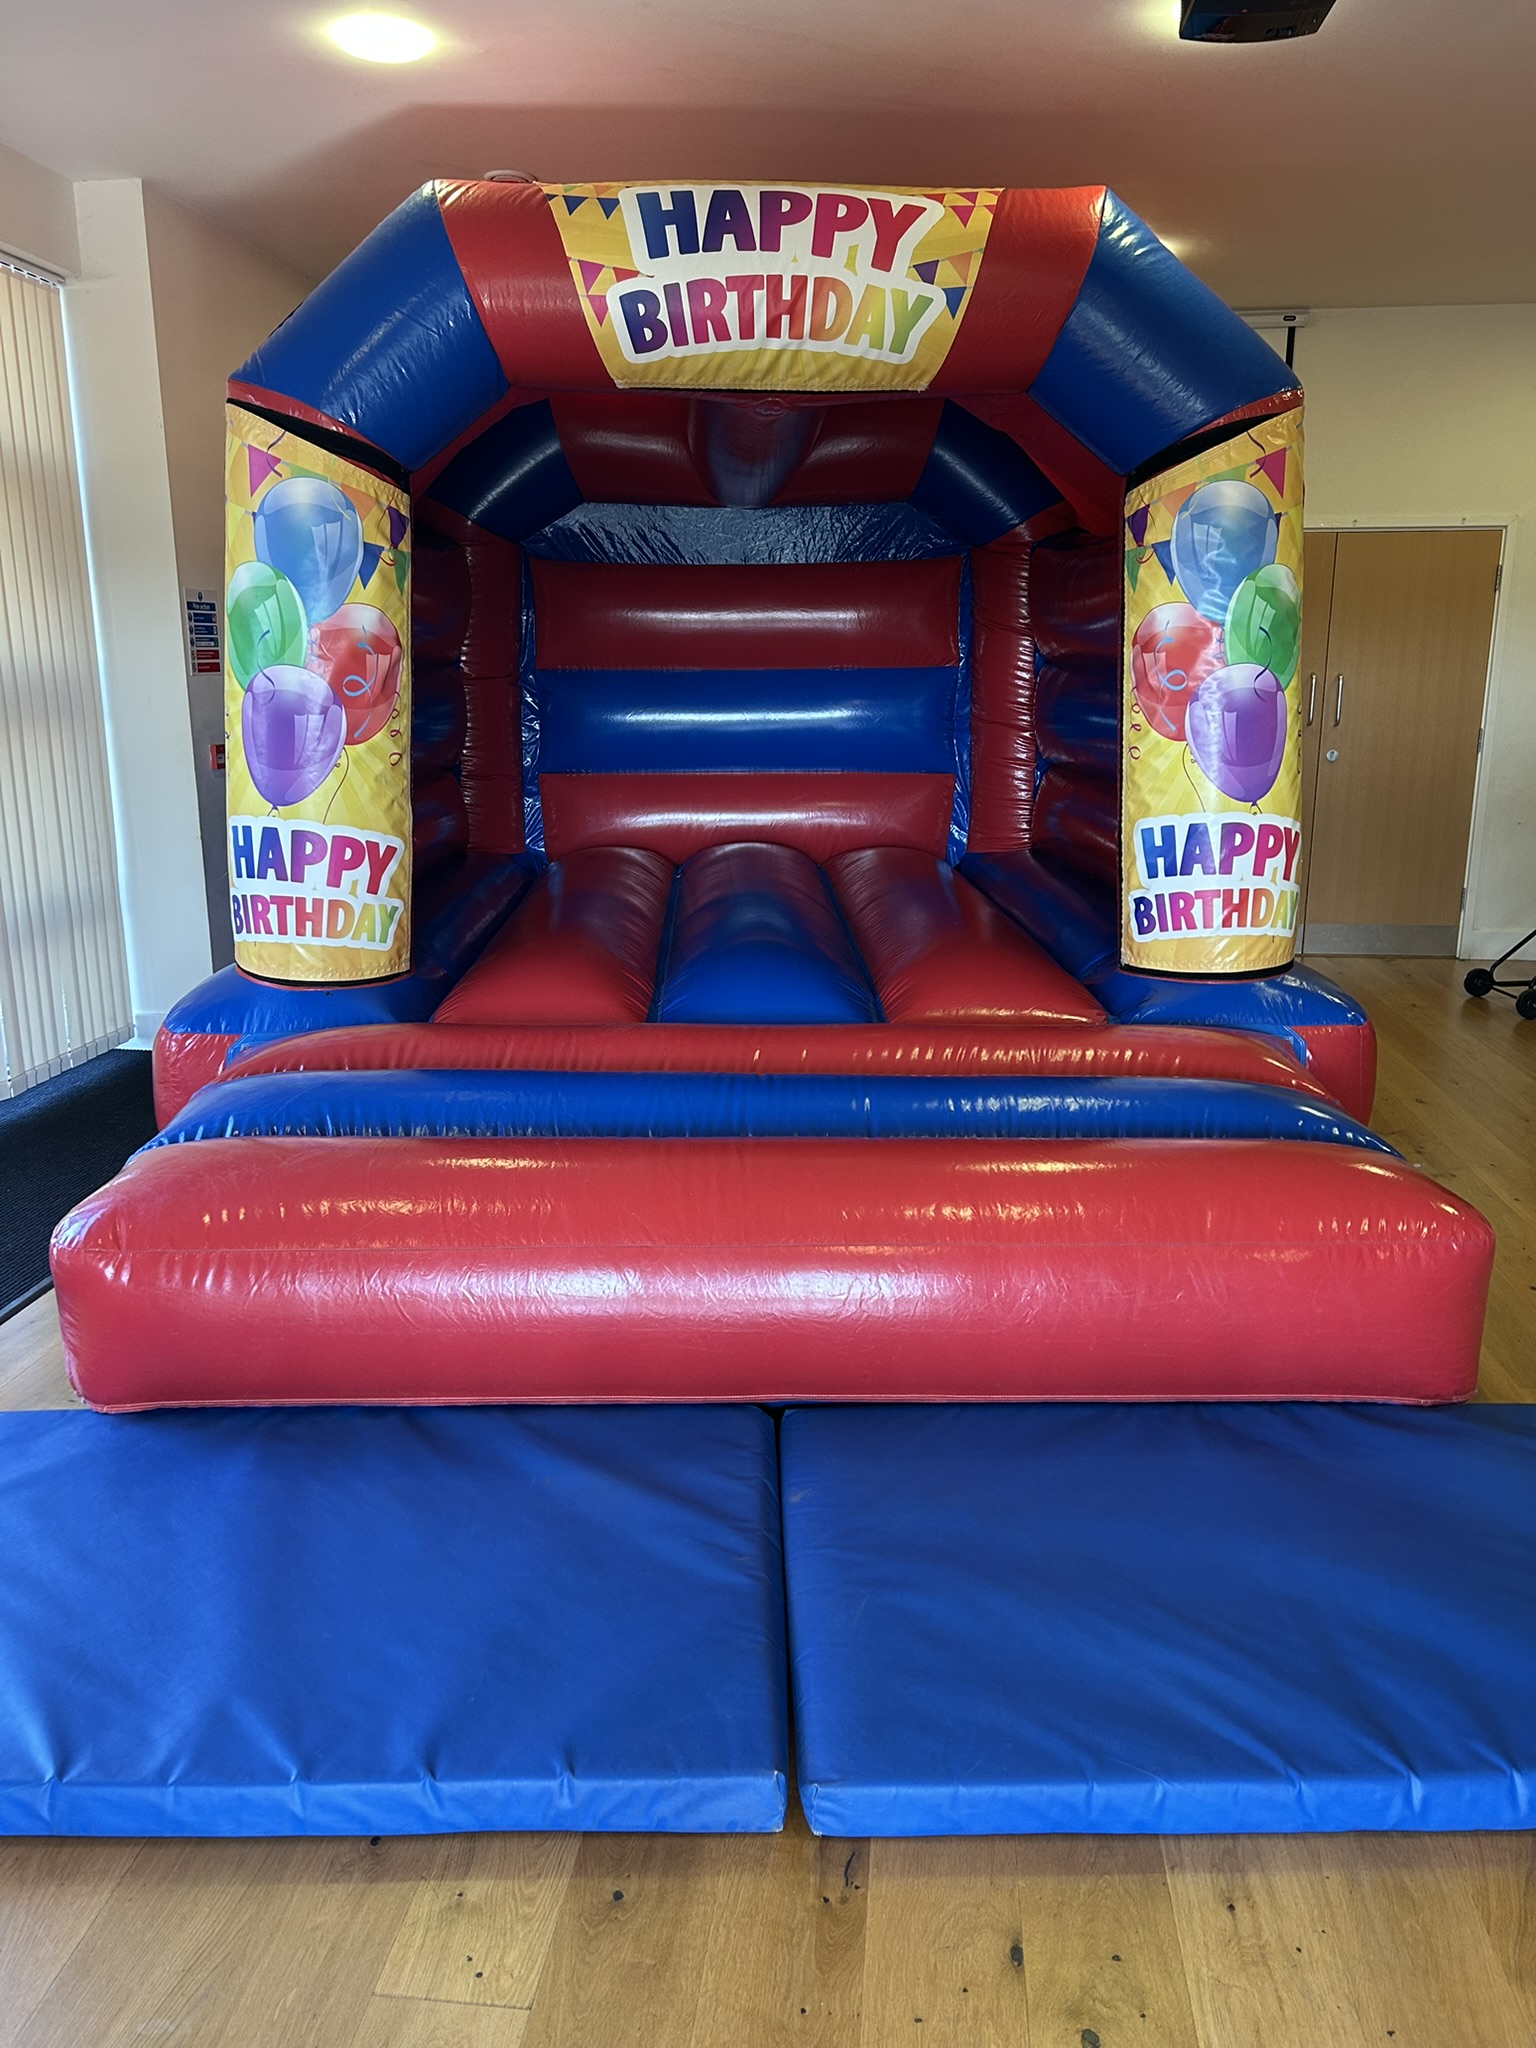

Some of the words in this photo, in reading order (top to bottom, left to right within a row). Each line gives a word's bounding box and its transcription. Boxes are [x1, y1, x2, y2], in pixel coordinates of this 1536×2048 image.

[635, 189, 927, 273] HAPPY
[619, 274, 935, 355] BIRTHDAY
[231, 825, 398, 896] HAPPY
[1140, 821, 1300, 882] HAPPY
[231, 894, 399, 944] BIRTHDAY
[1133, 888, 1299, 936] BIRTHDAY
